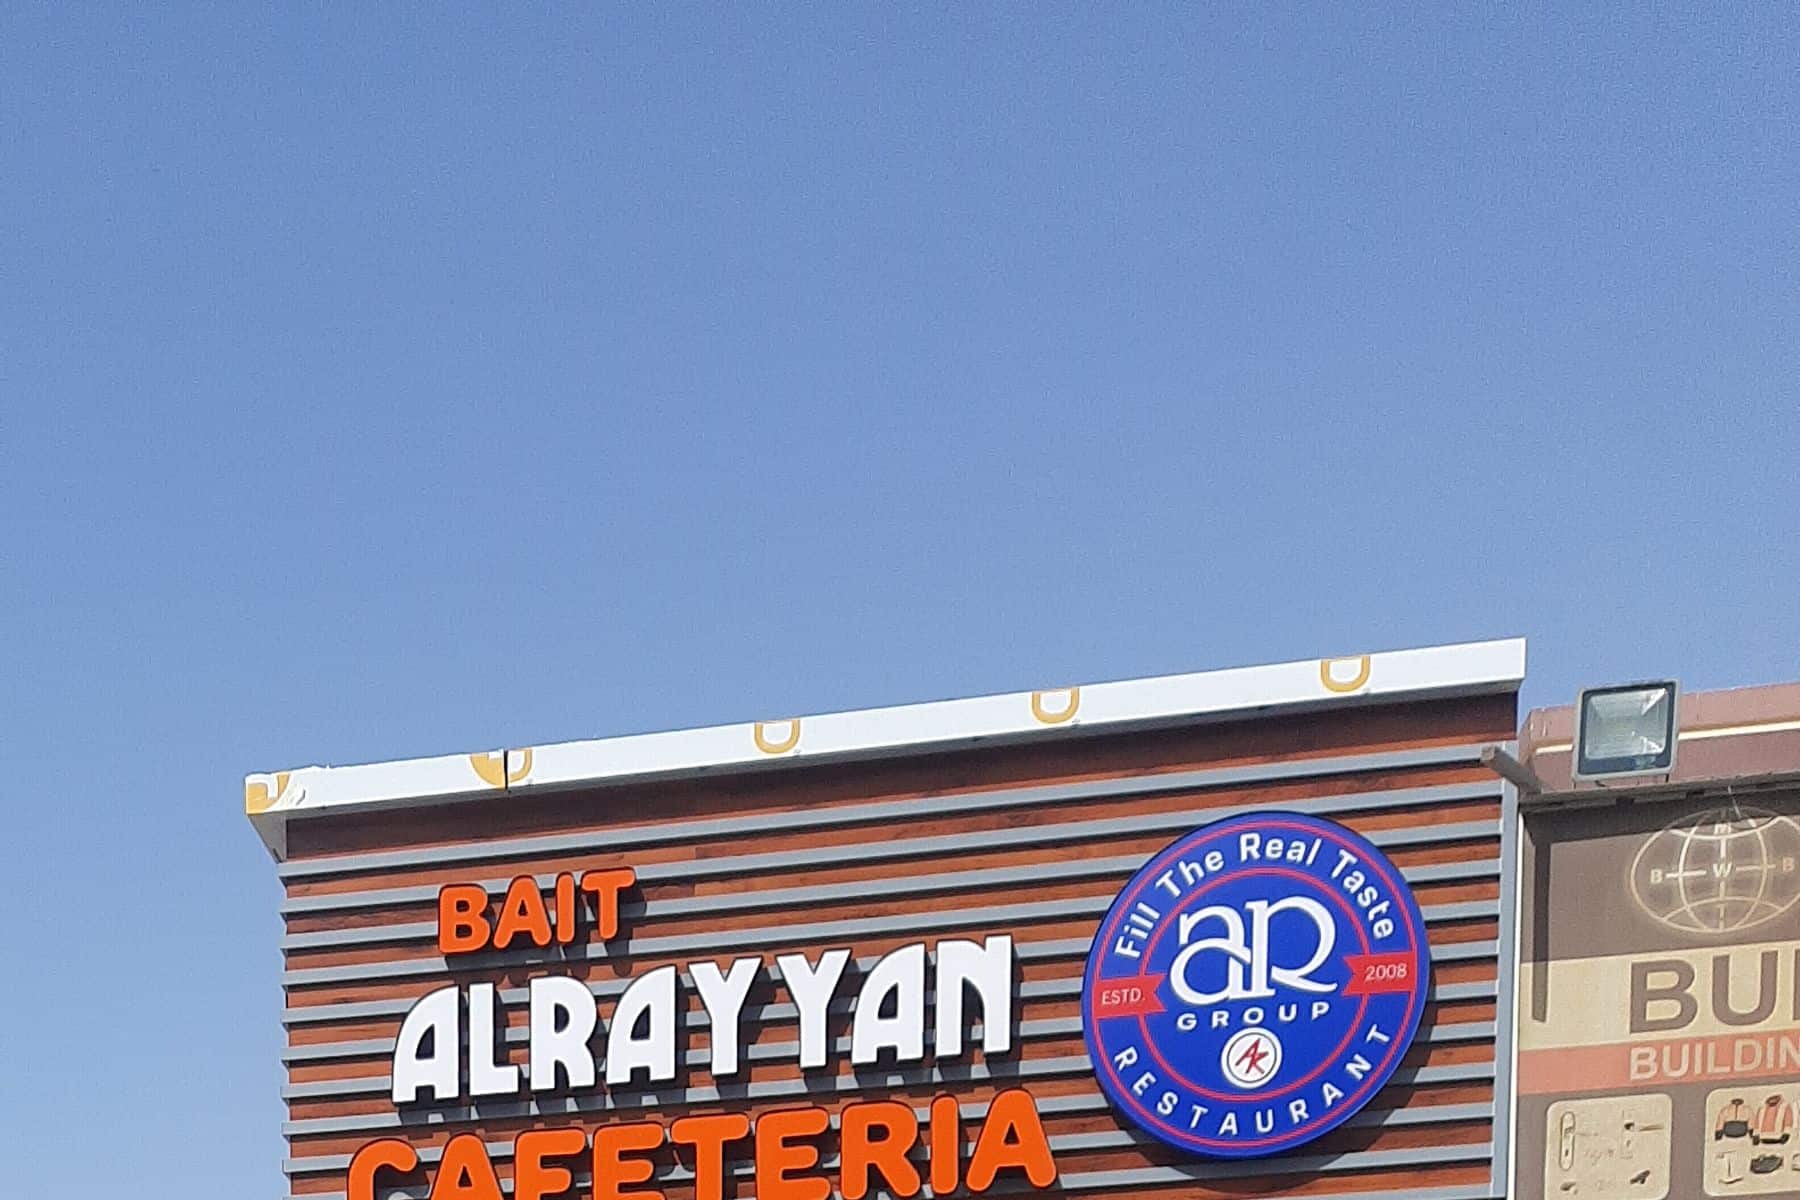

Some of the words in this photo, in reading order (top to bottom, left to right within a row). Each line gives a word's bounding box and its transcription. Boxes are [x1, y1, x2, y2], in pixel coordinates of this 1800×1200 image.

[438, 866, 637, 955] BAIT
[1114, 902, 1161, 959] Fill
[1155, 850, 1225, 898] The
[1239, 832, 1323, 867] Real
[1331, 849, 1395, 940] Taste
[391, 934, 1014, 1104] ALRAYYAN
[1176, 1001, 1330, 1032] GROUP
[1366, 963, 1408, 982] 2008
[1114, 1024, 1391, 1137] RESTAURANT
